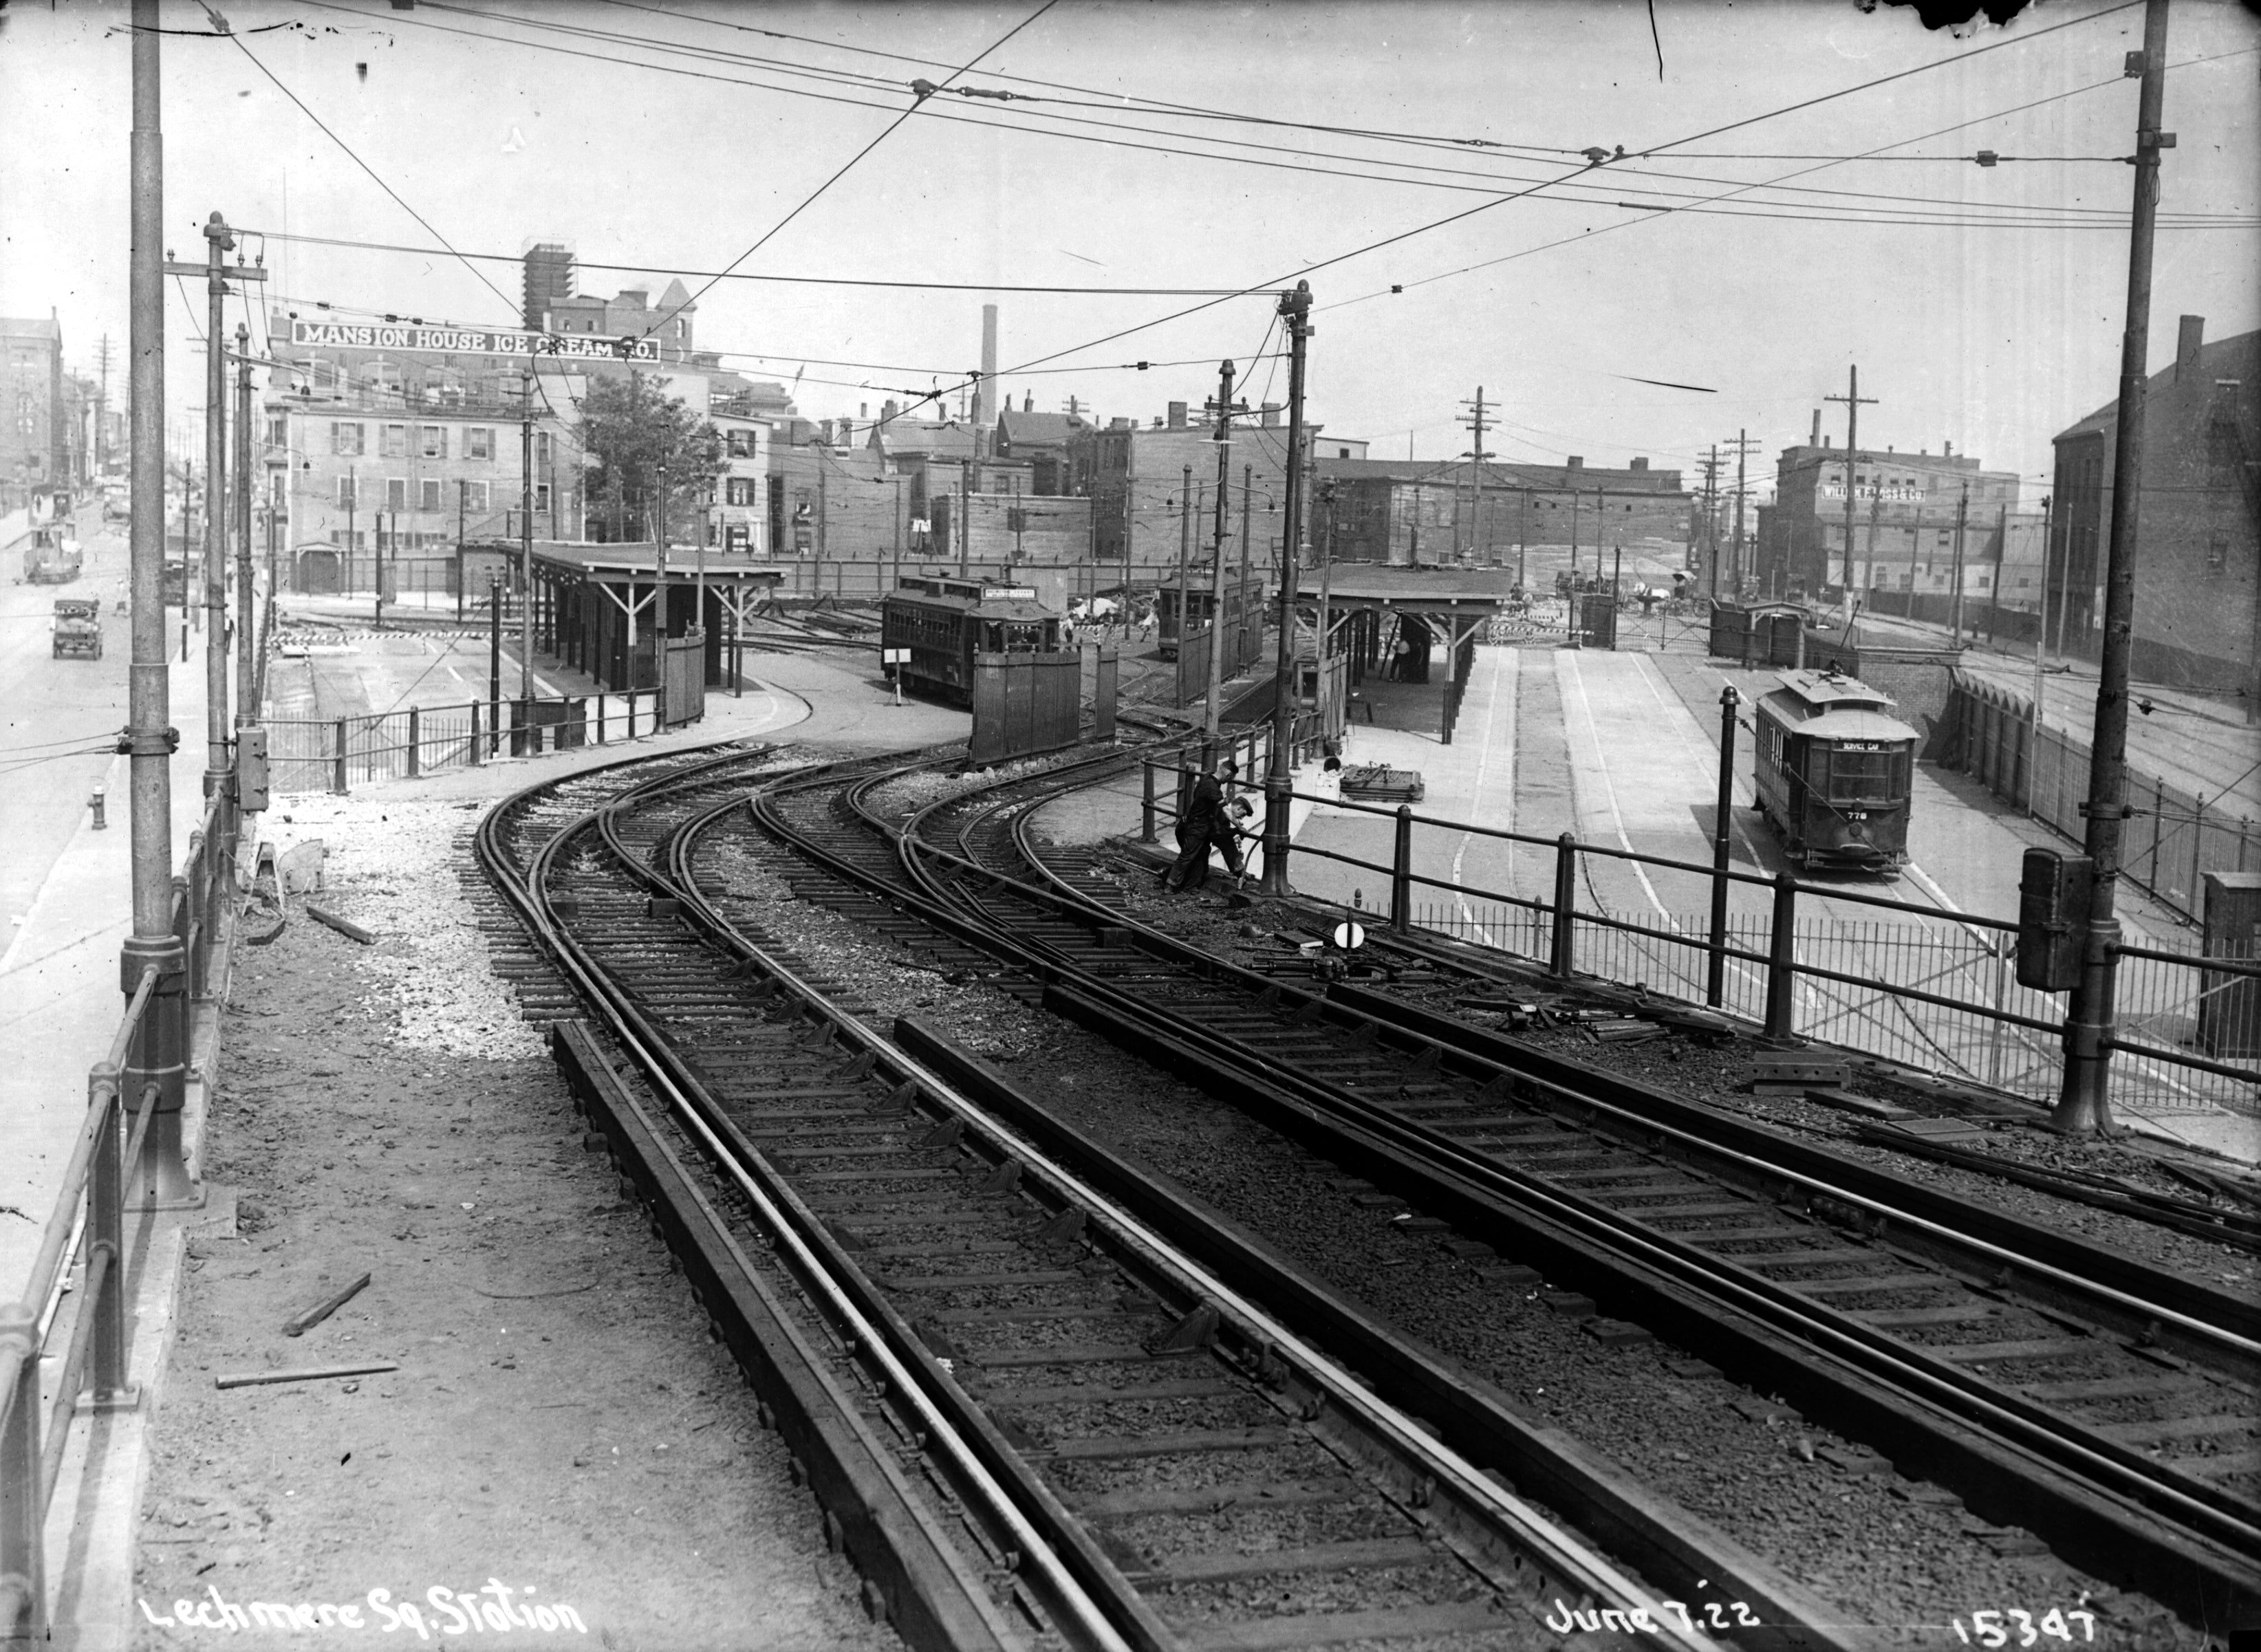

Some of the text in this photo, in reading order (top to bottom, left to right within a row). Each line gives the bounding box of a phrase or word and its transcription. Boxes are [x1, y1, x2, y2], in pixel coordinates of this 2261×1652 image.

[304, 325, 409, 346] MANSION
[415, 330, 486, 351] HOUSE
[493, 335, 528, 353] ICE
[1824, 486, 1861, 499] WILLIM
